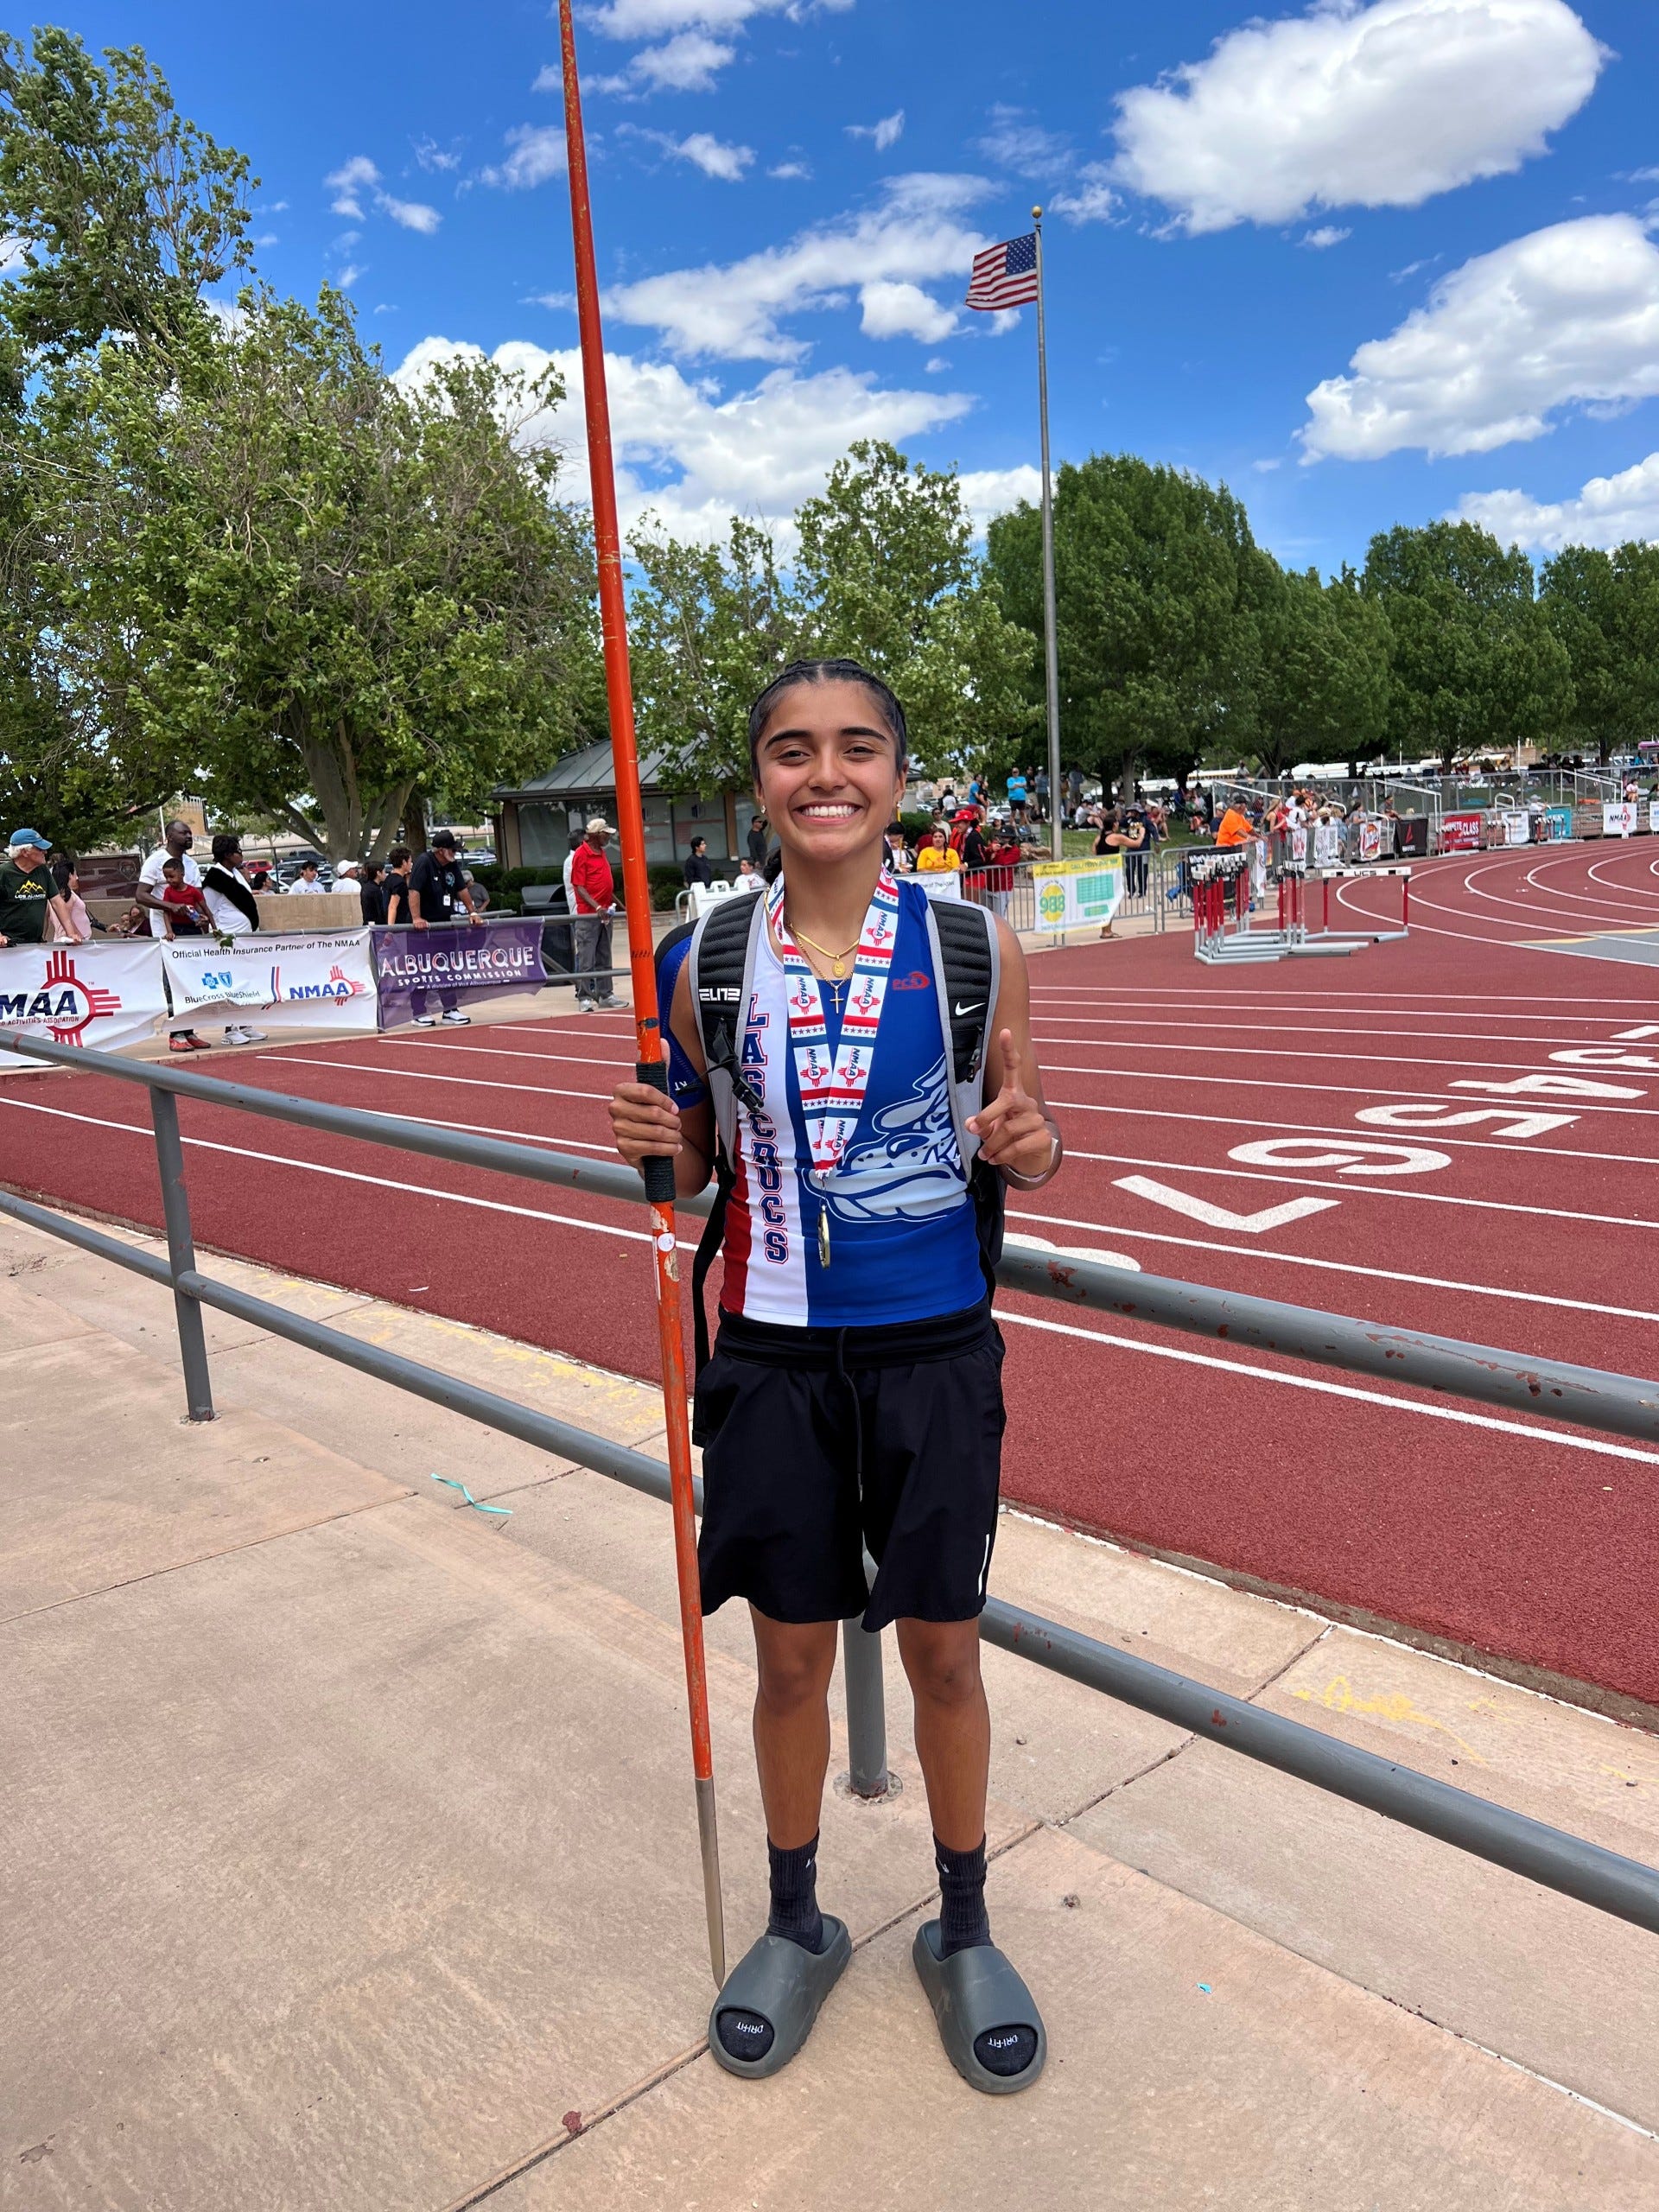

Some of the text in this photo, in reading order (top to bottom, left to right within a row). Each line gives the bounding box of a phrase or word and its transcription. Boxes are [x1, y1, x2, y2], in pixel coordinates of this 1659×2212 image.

[1039, 894, 1065, 914] 988
[876, 911, 888, 938] NMAA
[172, 939, 361, 959] Official Health Insurance Partner of The NMAA
[381, 946, 535, 977] ALBUQUERQUE
[289, 982, 349, 1000] NMAA
[397, 969, 522, 987] SPORTS COMMISSION
[797, 976, 809, 1004] NMAA
[863, 977, 875, 1005] NMAA
[184, 994, 225, 1004] BlueCross
[699, 988, 741, 1001] ELITE
[7, 1016, 41, 1027] ACTIVITIES
[807, 1048, 819, 1077] NMAA
[849, 1047, 861, 1077] NMAA
[1447, 1074, 1649, 1099] 4
[834, 1119, 846, 1148] NMAA
[1355, 1103, 1582, 1138] 5
[1227, 1138, 1452, 1175] 6
[747, 1110, 789, 1265] CRUCS
[1110, 1175, 1342, 1234] 7
[987, 2034, 1019, 2049] DRI-FIT
